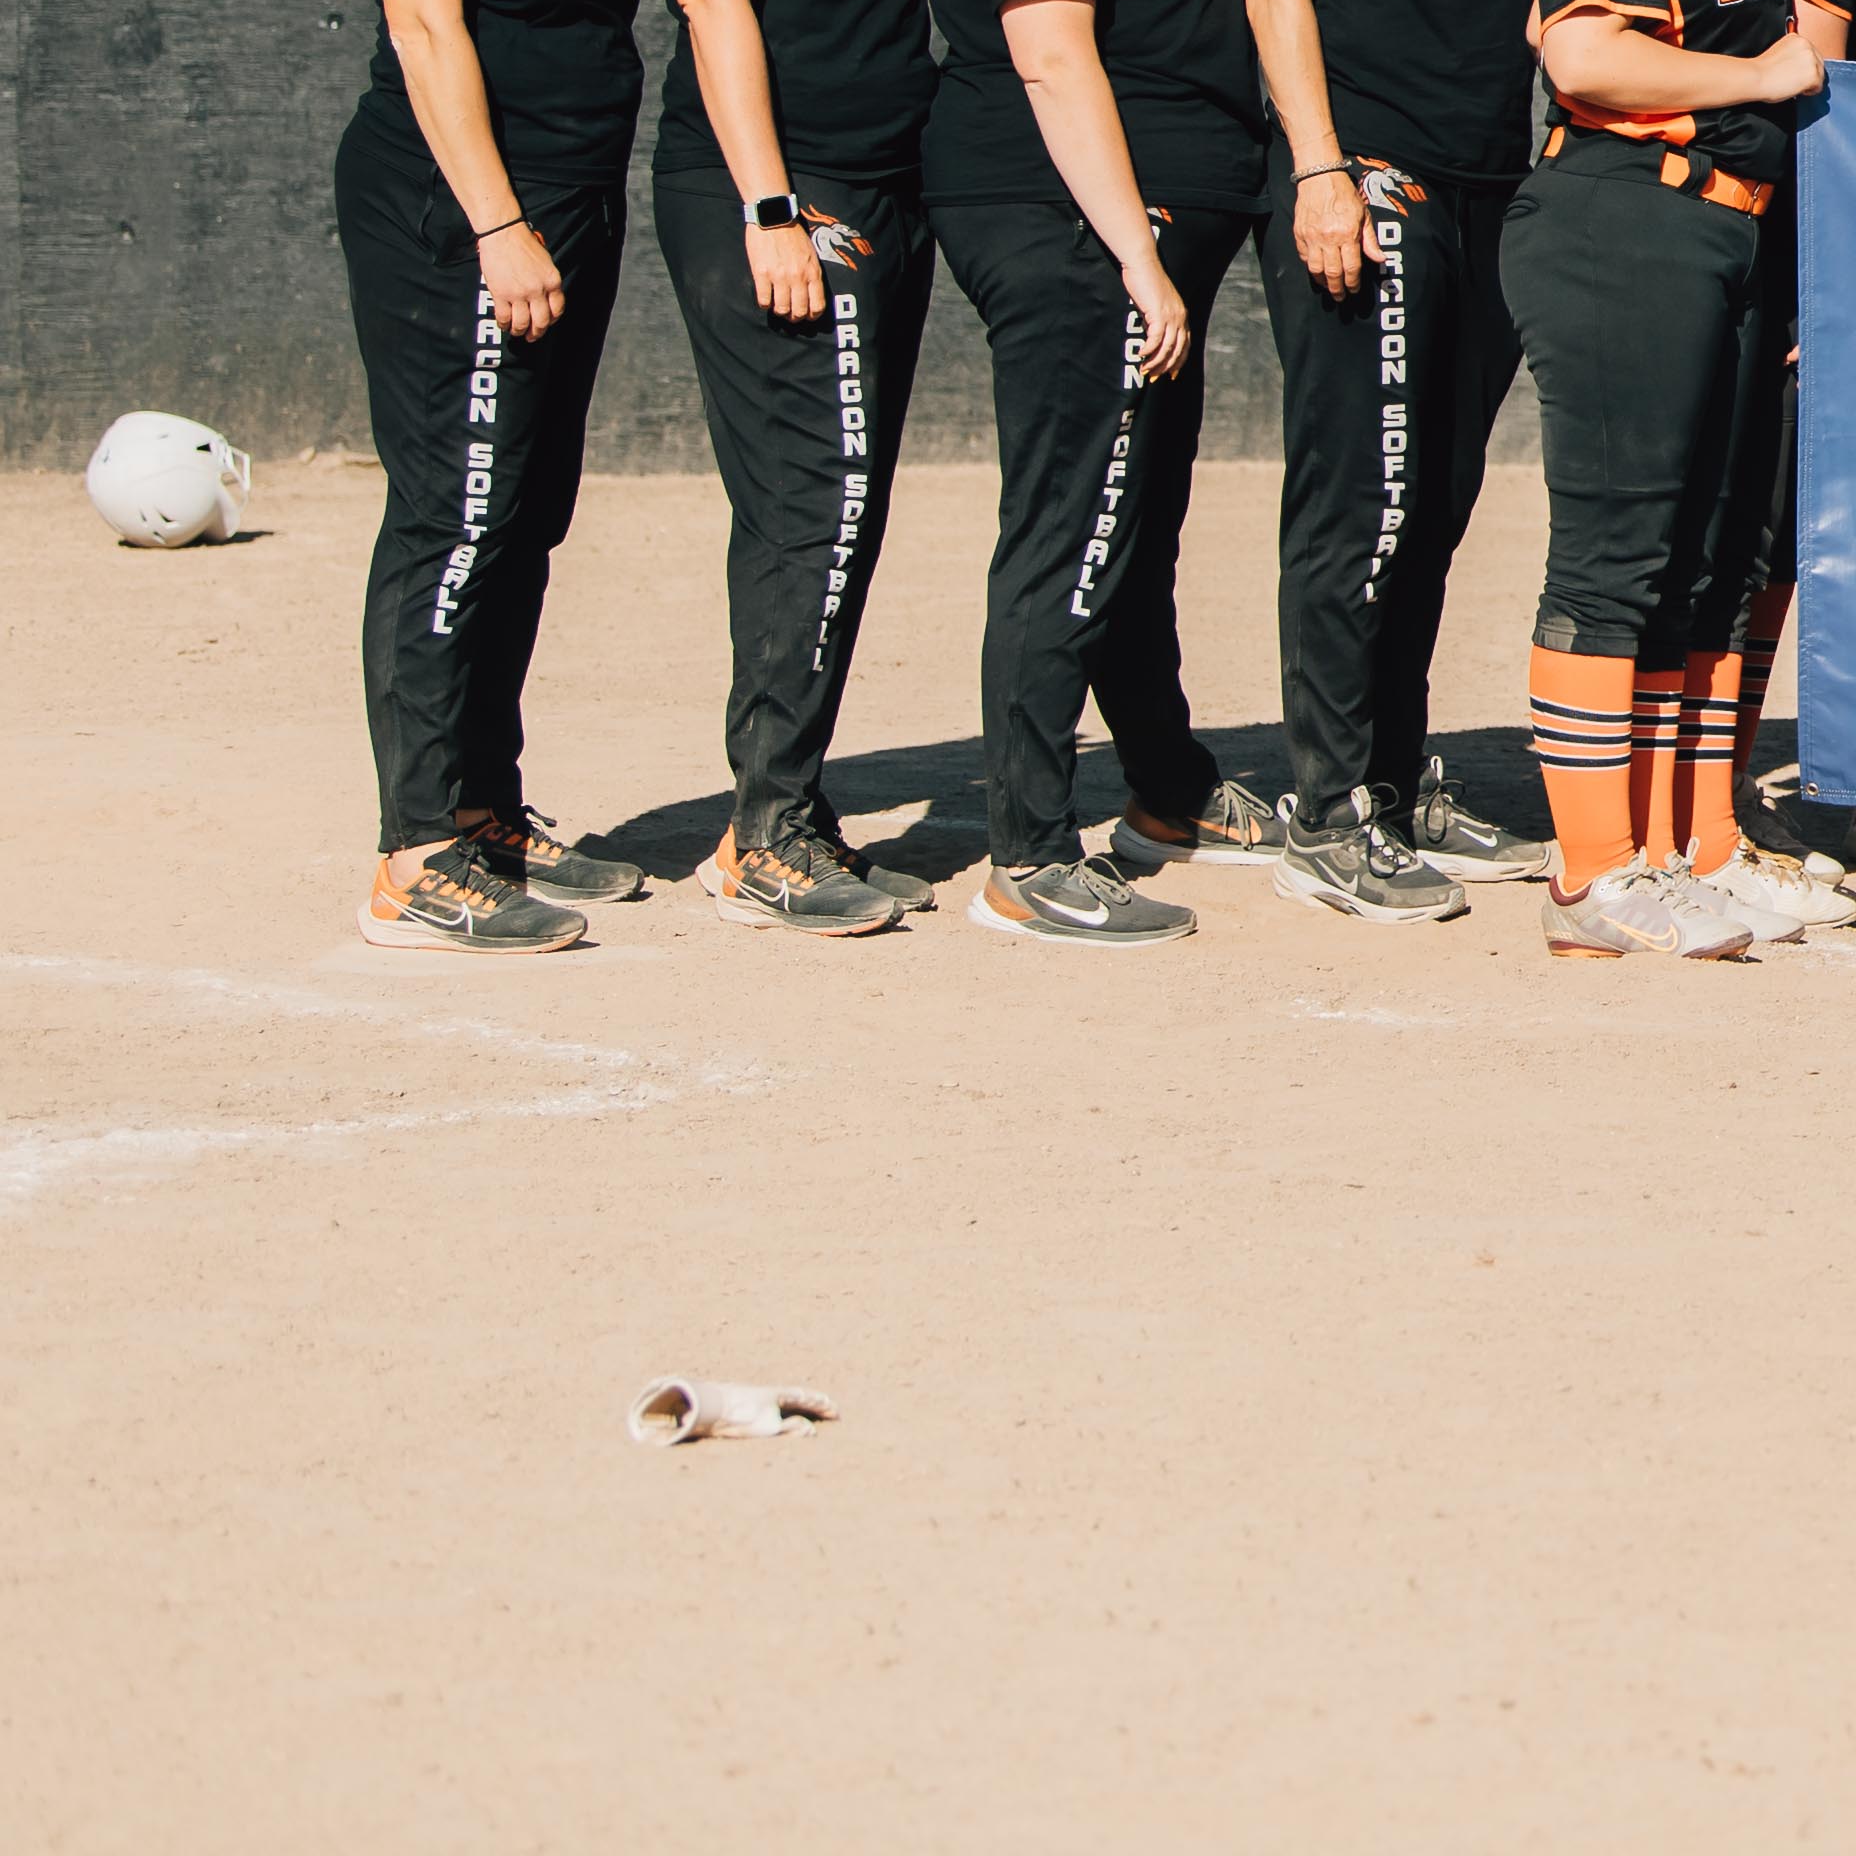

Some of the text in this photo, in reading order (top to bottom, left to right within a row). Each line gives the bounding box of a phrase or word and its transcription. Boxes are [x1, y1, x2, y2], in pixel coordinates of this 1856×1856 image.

[432, 275, 502, 635] RAGON SOFTBALL
[812, 294, 868, 672] DRAGON SOFTBALL
[1070, 408, 1136, 618] SOFTBALL
[1364, 221, 1408, 604] DRAGON SOFTBALL
